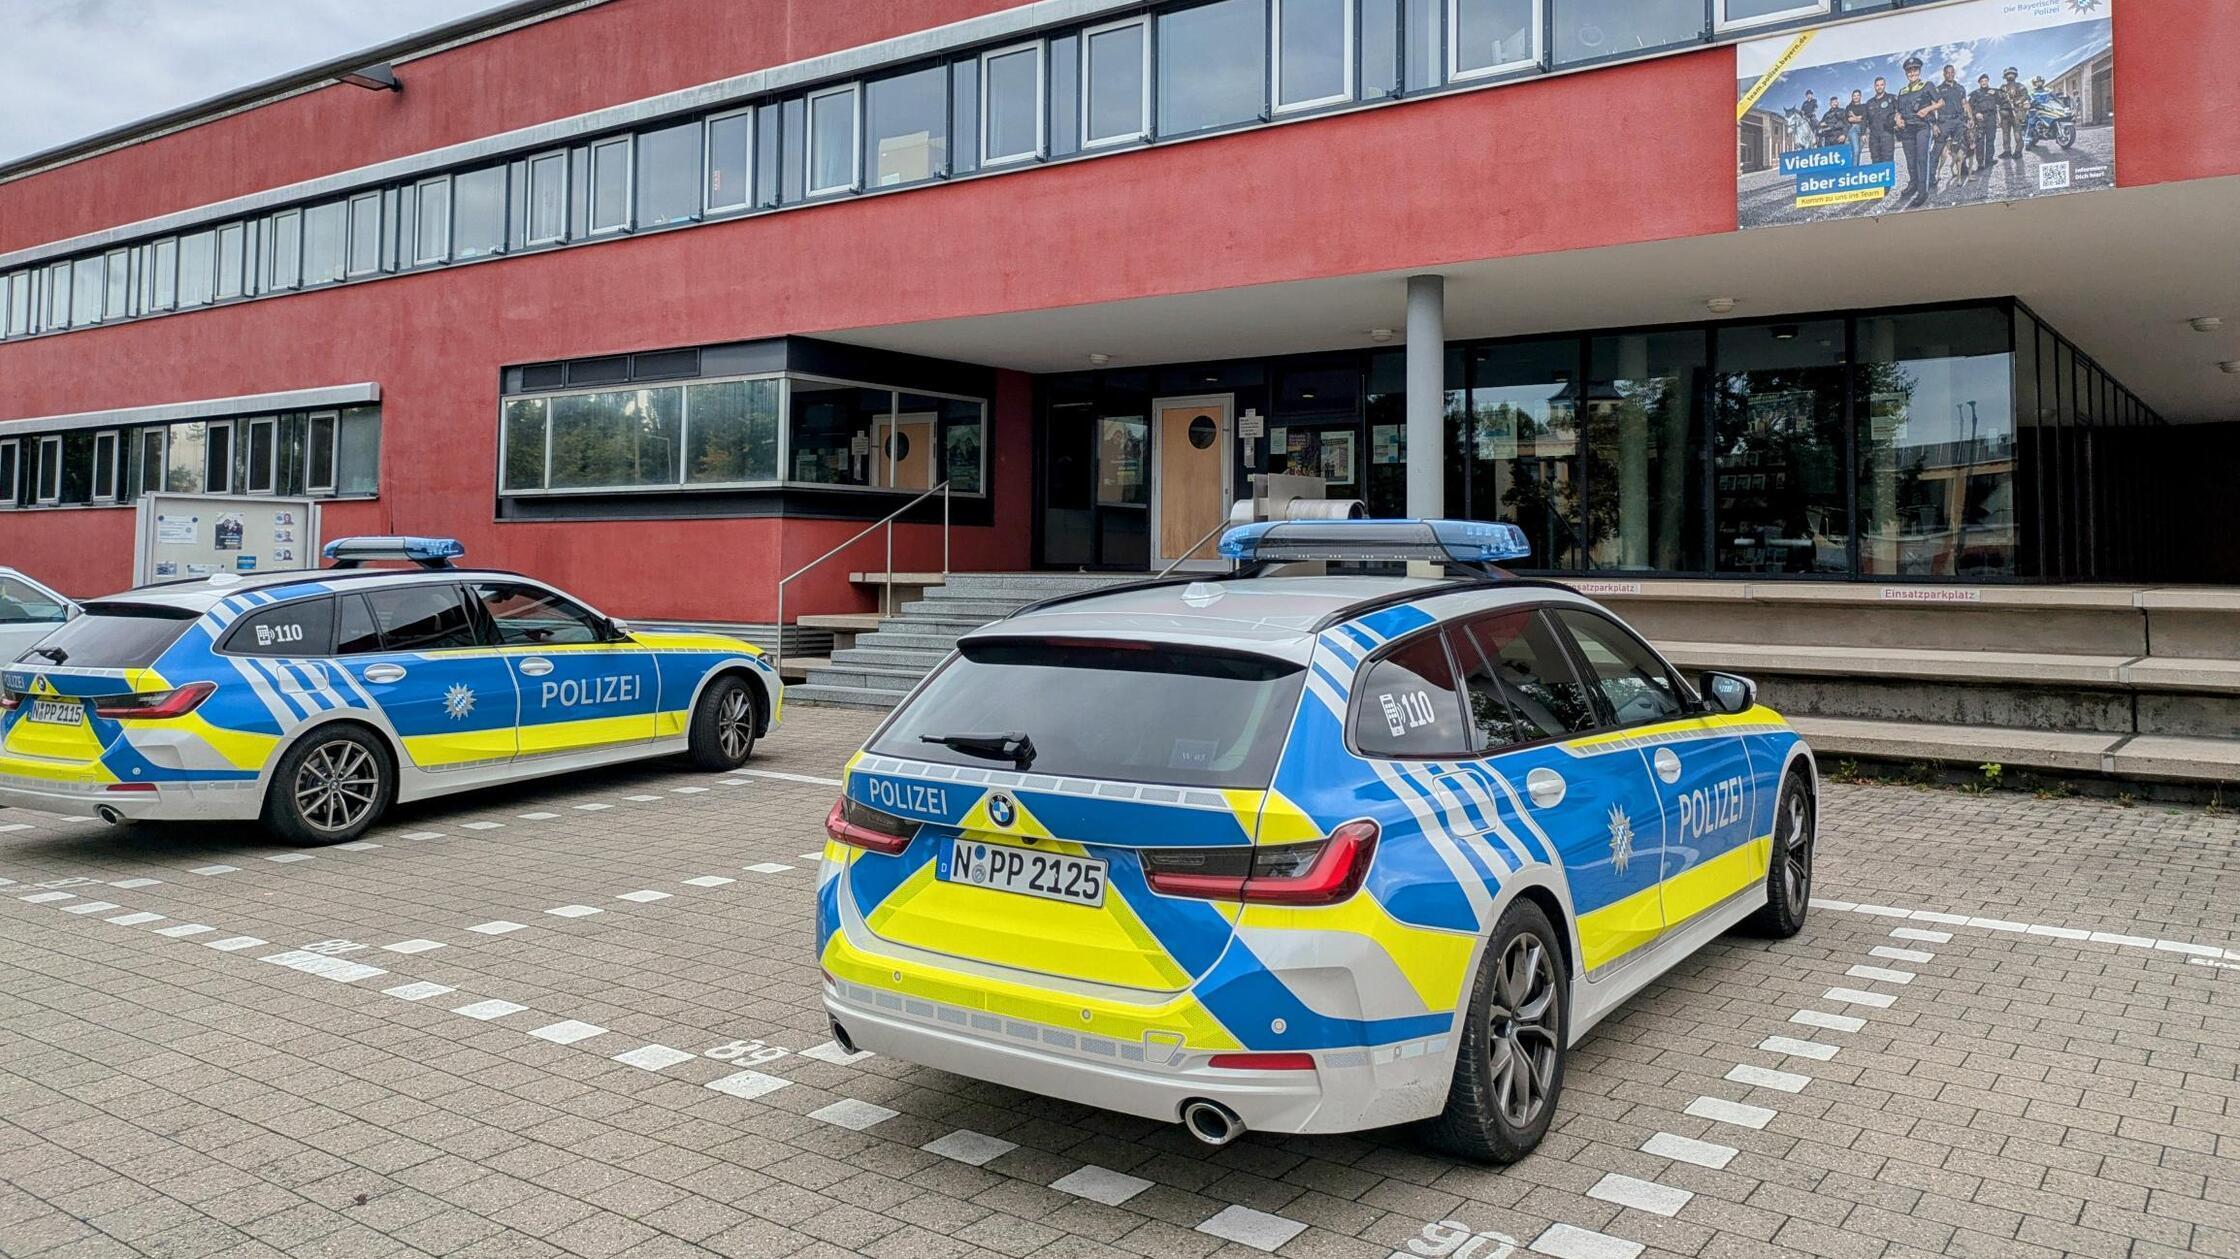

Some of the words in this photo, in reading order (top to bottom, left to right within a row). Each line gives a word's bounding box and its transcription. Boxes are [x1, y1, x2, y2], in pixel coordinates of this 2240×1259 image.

[1747, 35, 1807, 102] team.polizei.bayern.de
[1785, 151, 1846, 171] Vielfalt,
[1800, 177, 1836, 192] aber
[1838, 168, 1891, 187] sicher!
[1565, 583, 1634, 593] nsatzparkplatz
[1885, 589, 1976, 600] Einsatzparkplatz
[275, 624, 303, 642] 110
[541, 674, 640, 708] POLIZEI
[33, 703, 40, 718] N
[45, 703, 57, 720] PP
[58, 705, 81, 722] 2115
[1401, 690, 1435, 728] 110
[869, 777, 948, 816] POLIZEI
[1678, 775, 1744, 845] POLIZEI
[940, 862, 948, 873] D
[953, 844, 972, 879] N
[989, 850, 1024, 886] PP
[1029, 856, 1102, 900] 2125
[704, 1039, 792, 1067] 89
[1407, 1220, 1518, 1259] 90
